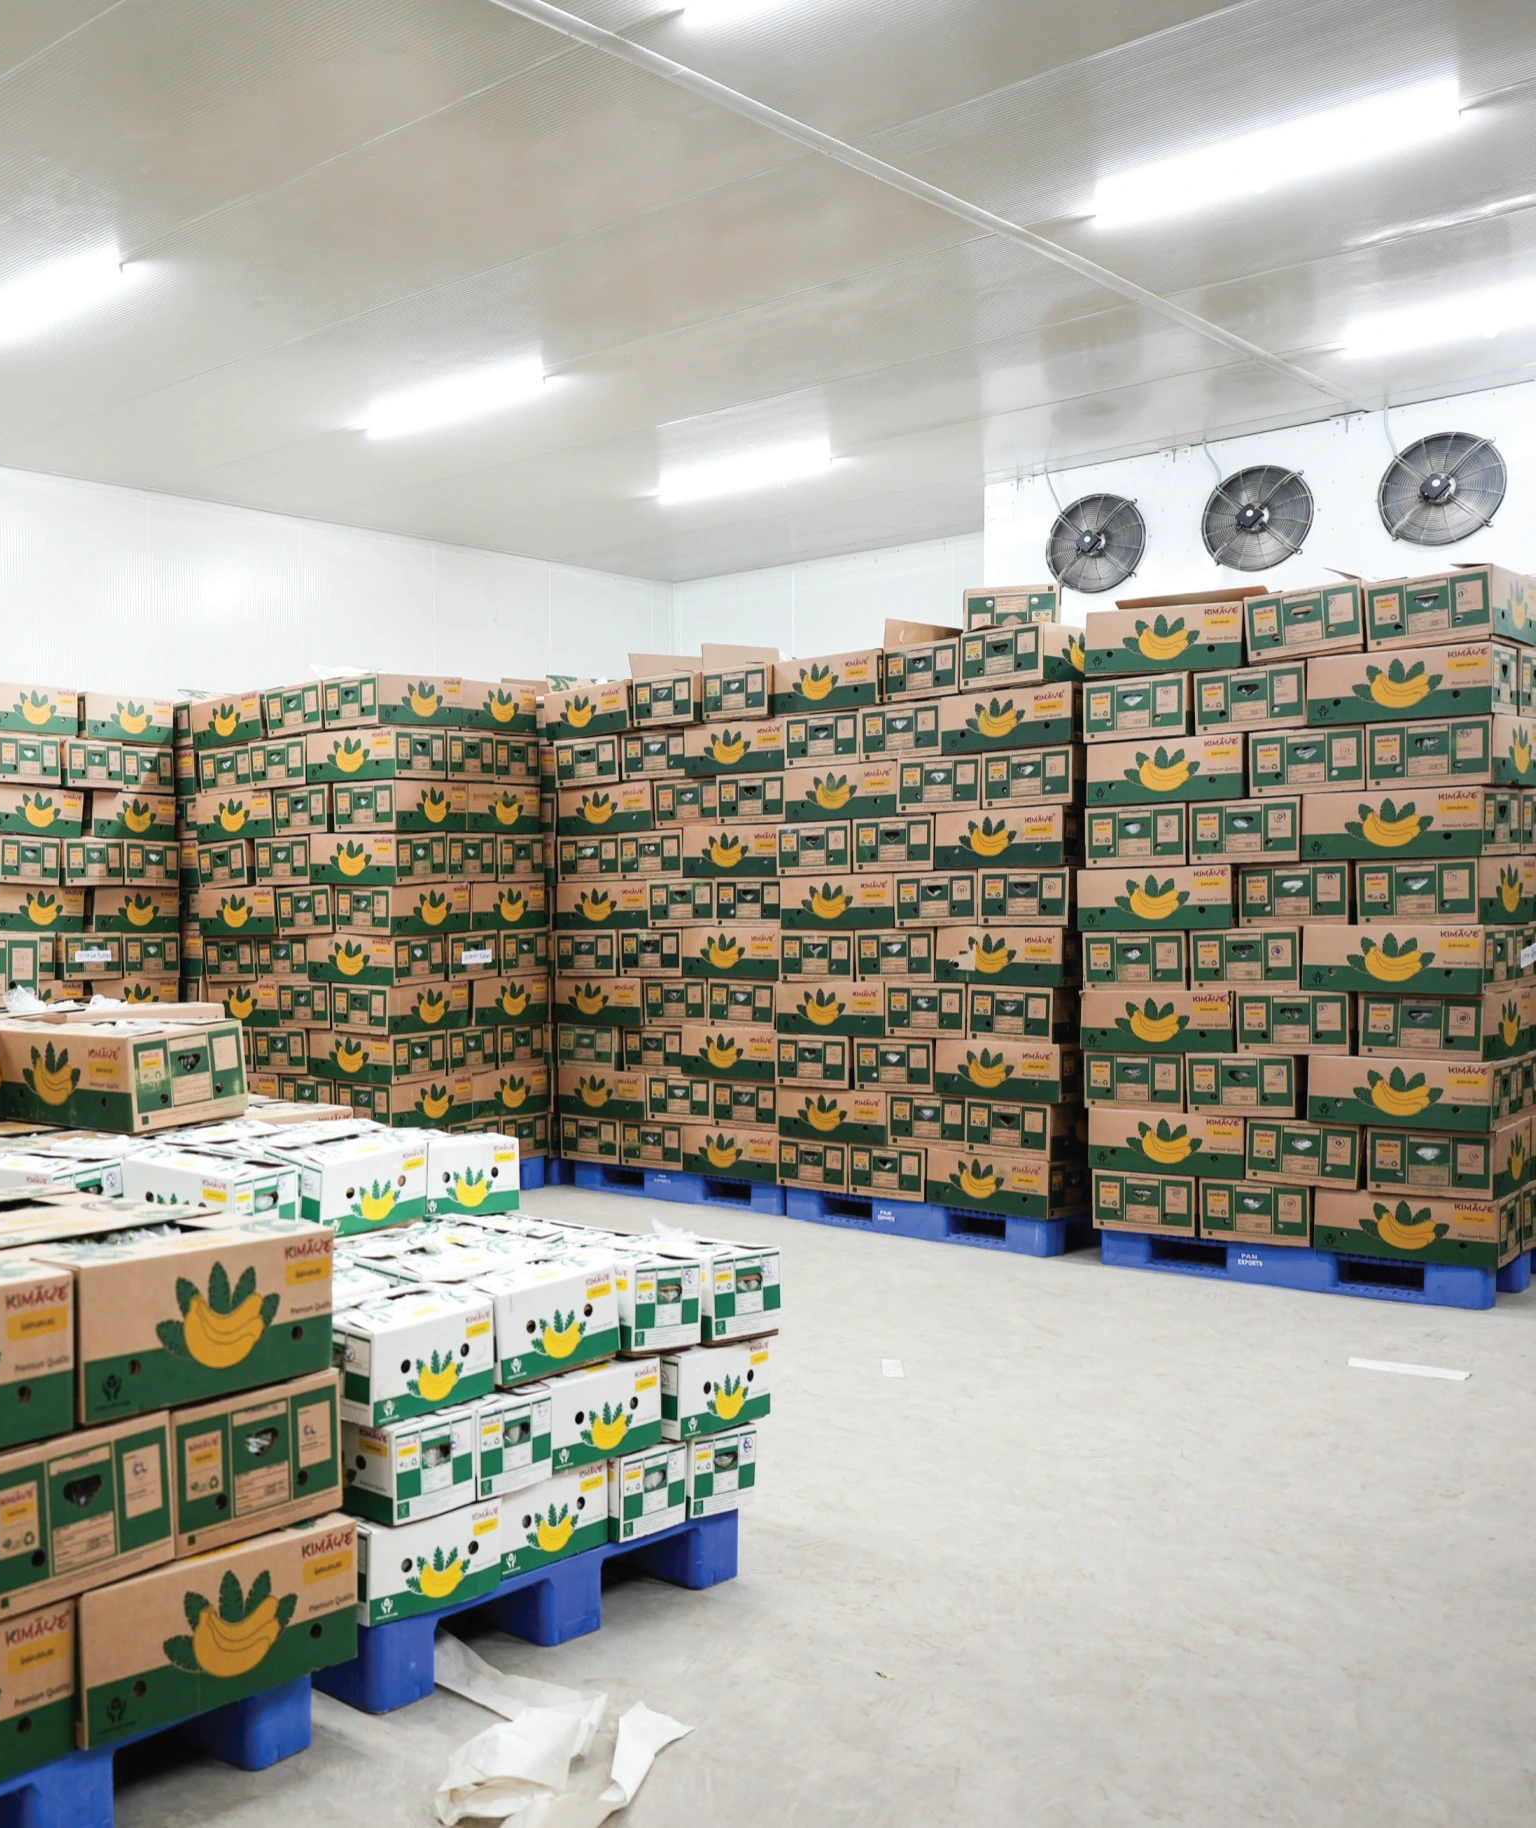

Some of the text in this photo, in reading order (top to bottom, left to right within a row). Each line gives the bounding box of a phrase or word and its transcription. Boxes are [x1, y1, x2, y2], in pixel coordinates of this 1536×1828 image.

[877, 1214, 896, 1223] EXPORTS
[1237, 1259, 1263, 1267] EXPORTS
[290, 1303, 312, 1315] Premium
[15, 1353, 69, 1374] Premium Quality
[309, 1590, 354, 1613] Premium Quality
[14, 1679, 70, 1708] Premium Quality
